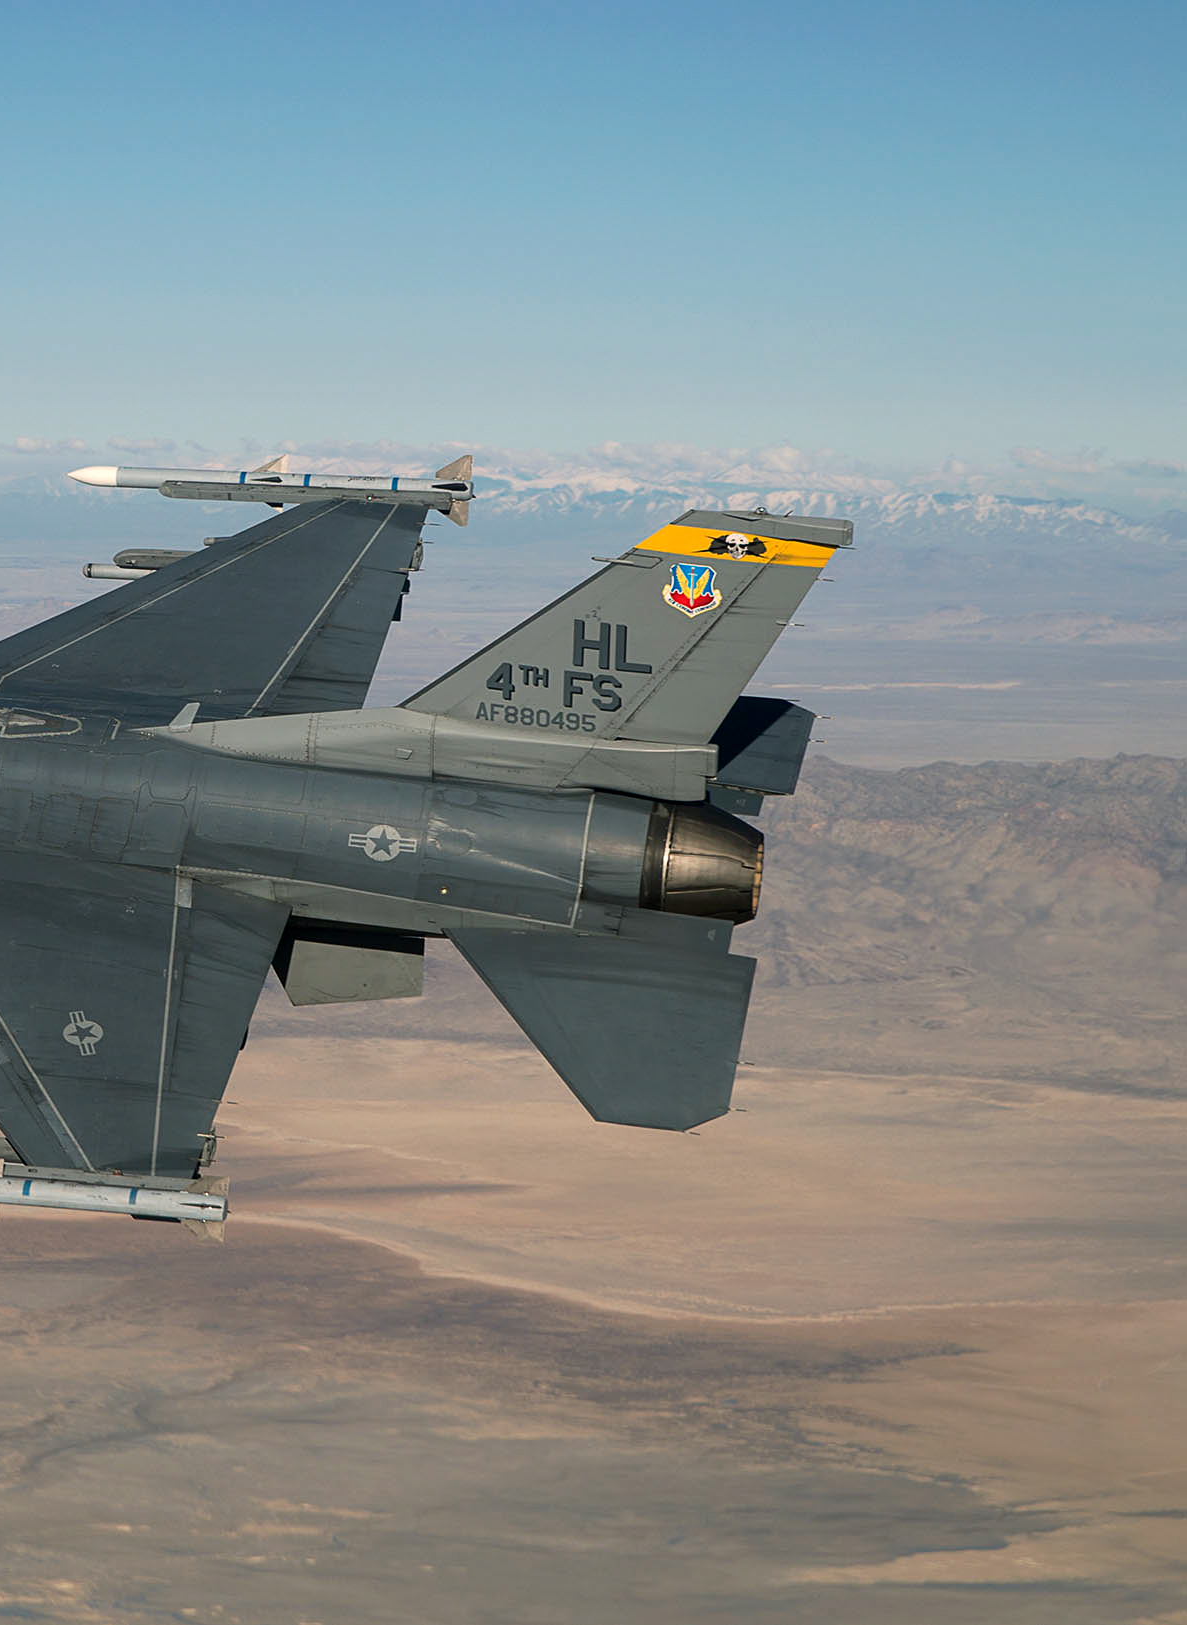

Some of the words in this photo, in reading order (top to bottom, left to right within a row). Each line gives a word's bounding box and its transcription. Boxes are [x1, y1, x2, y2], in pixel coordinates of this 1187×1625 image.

[572, 619, 653, 674] HL
[563, 670, 623, 713] FS
[475, 701, 597, 733] AF880495
